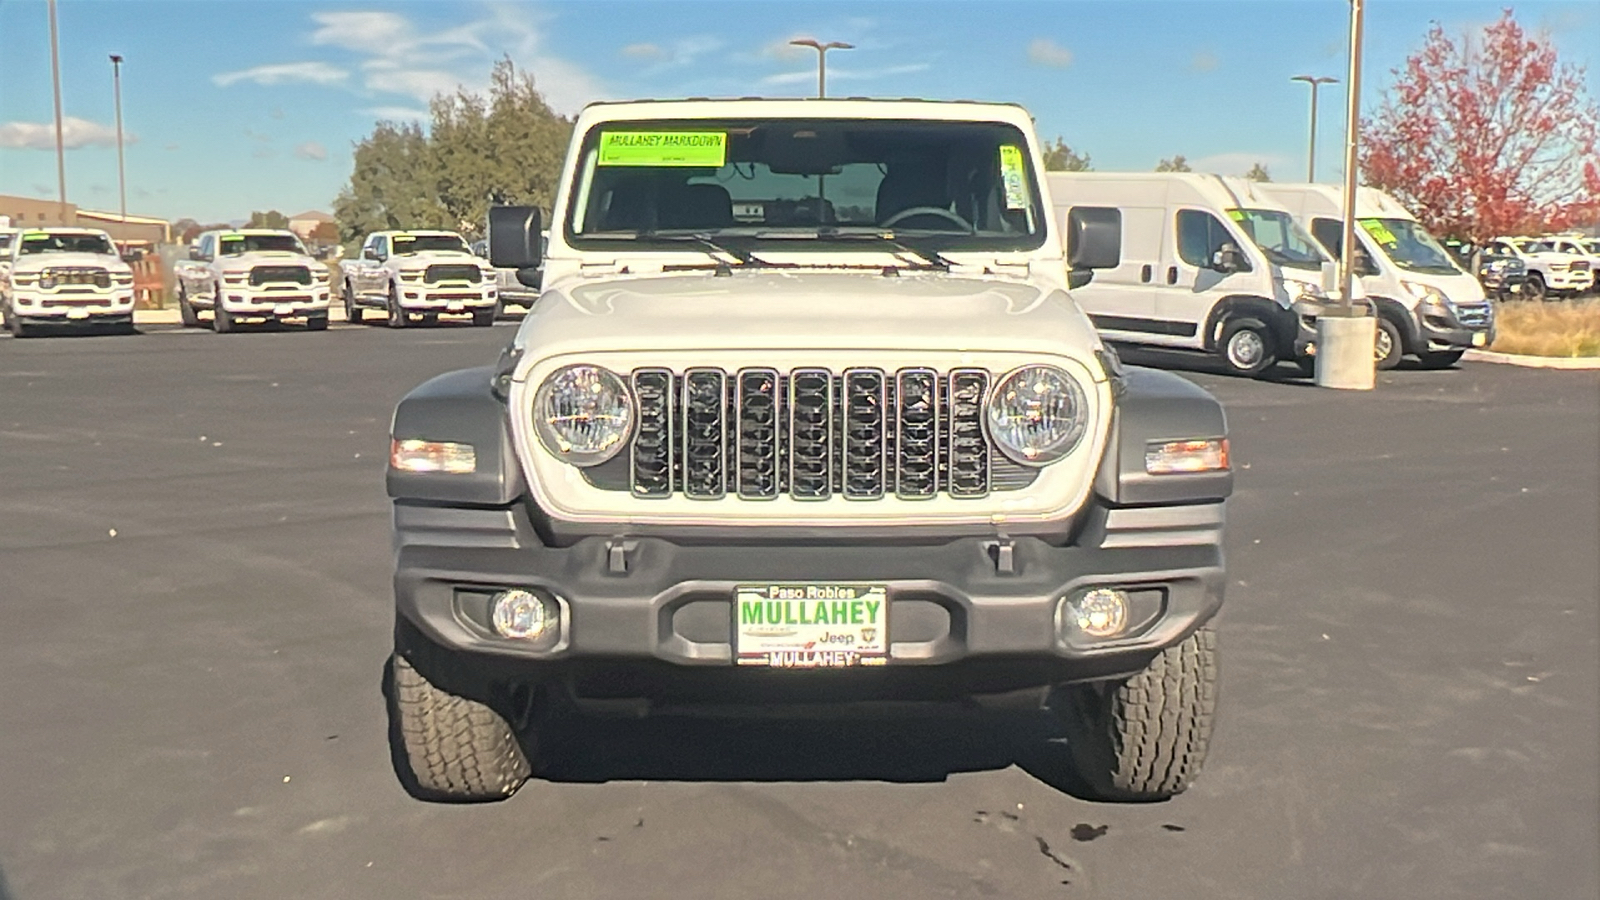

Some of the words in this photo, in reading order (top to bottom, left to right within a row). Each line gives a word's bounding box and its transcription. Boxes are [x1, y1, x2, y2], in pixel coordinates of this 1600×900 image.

[609, 135, 661, 146] MULLAHEY
[663, 135, 722, 146] MARKDOWN
[770, 586, 804, 598] Paso
[807, 586, 855, 598] Robles
[742, 601, 881, 625] MULLAHEY
[819, 631, 855, 645] Jeep
[769, 652, 854, 667] MULLAHEY
